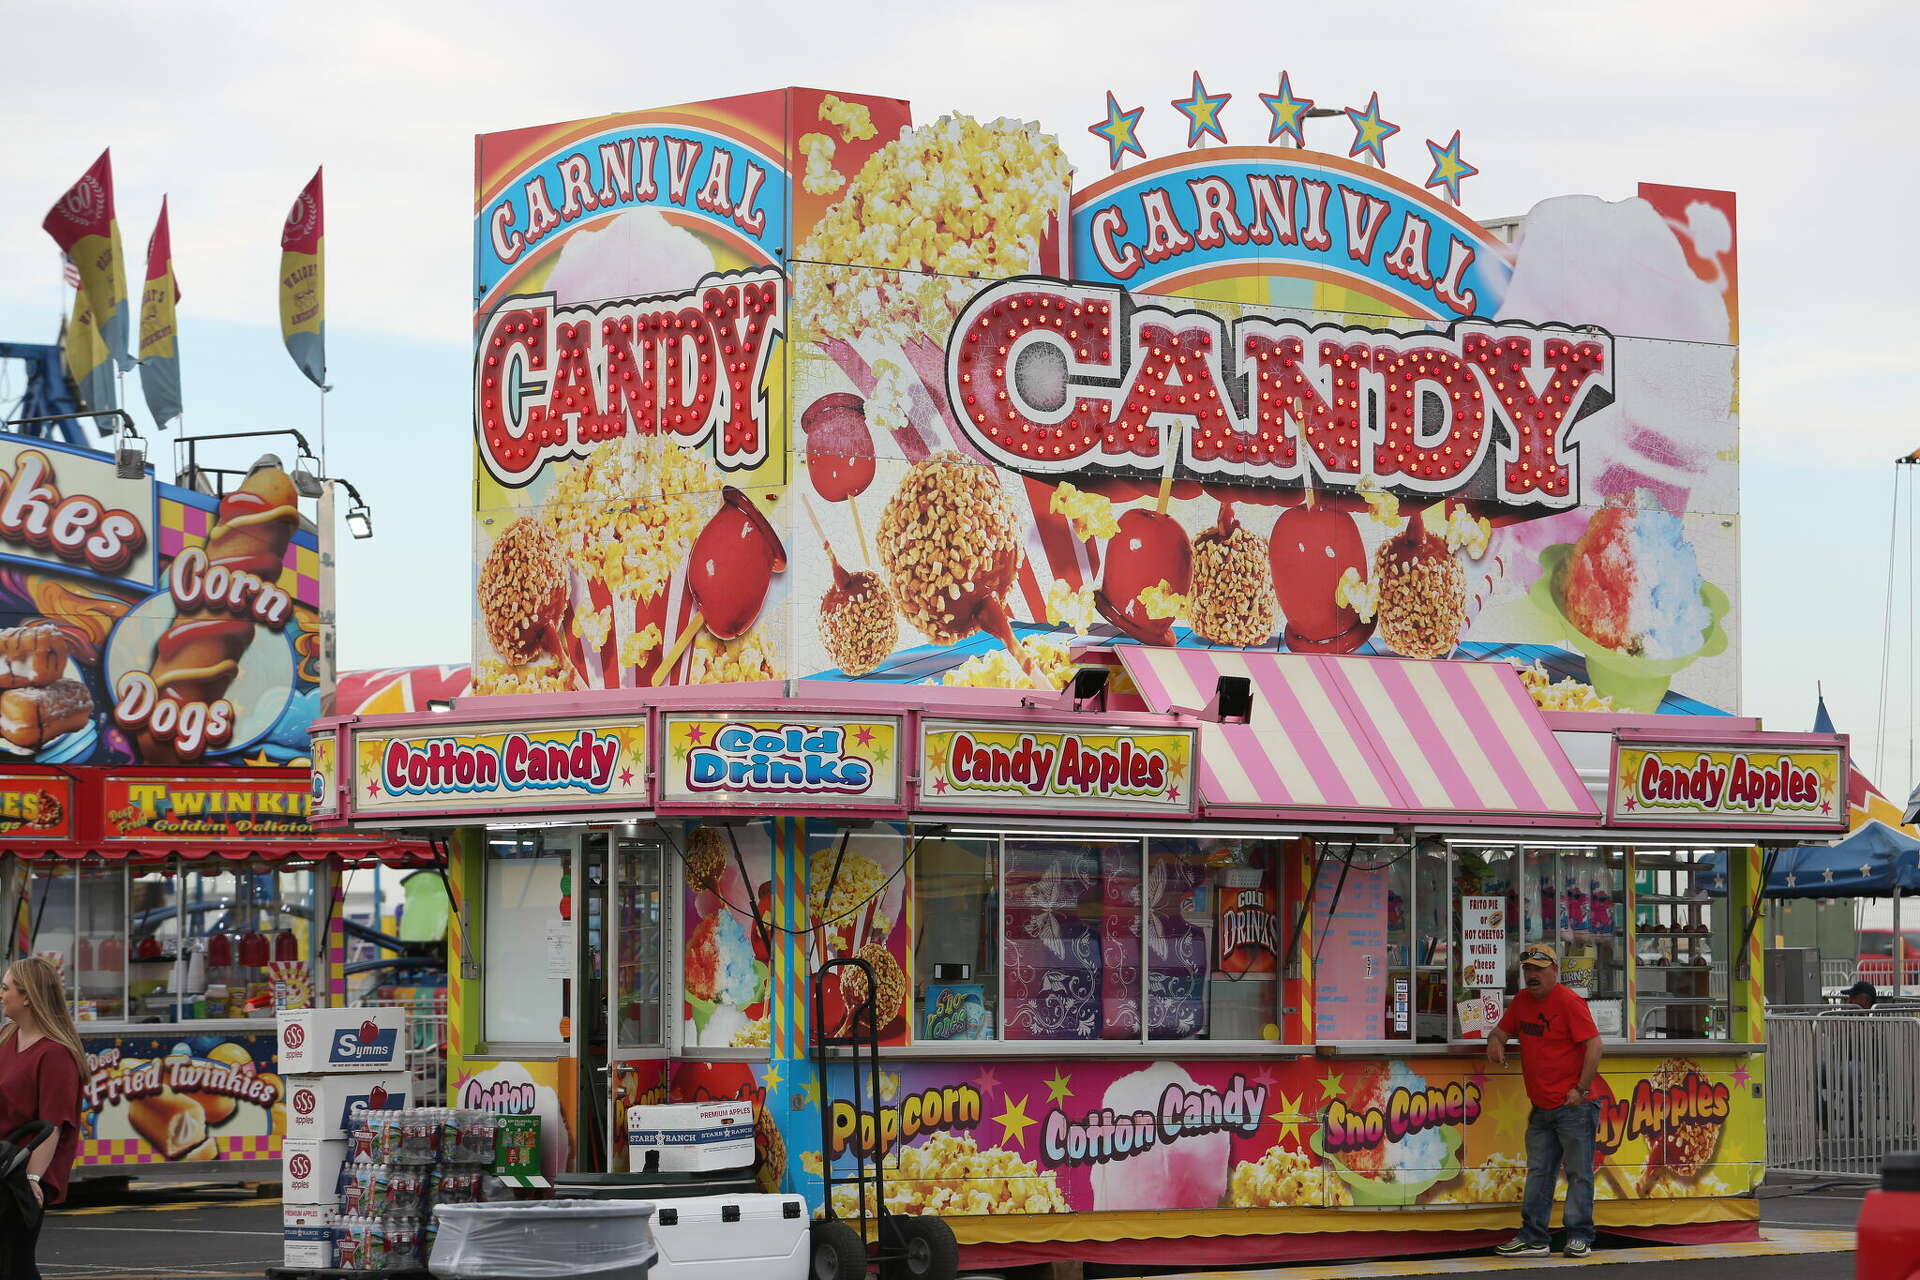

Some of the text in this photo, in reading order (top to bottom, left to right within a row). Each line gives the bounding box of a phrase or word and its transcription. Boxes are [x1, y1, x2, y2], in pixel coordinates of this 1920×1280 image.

[490, 136, 766, 265] CARNIVAL
[1089, 174, 1478, 317] CARNIVAL
[479, 278, 778, 476] CANDY
[952, 290, 1604, 498] CANDY
[0, 450, 142, 562] kes
[172, 548, 292, 626] Corn
[117, 672, 233, 755] Dogs
[386, 738, 497, 788] Cotton
[505, 731, 617, 787] Candy
[717, 727, 840, 755] Cold
[951, 734, 1164, 793] Candy Apples
[693, 751, 867, 787] Drinks
[1640, 756, 1818, 808] Candy Apples
[153, 819, 227, 833] Golden
[1237, 890, 1264, 908] COLD
[1469, 899, 1498, 910] FRITO PIE
[1480, 916, 1488, 925] or
[1223, 909, 1278, 956] DRINKS
[1464, 929, 1504, 940] HOT CHEETOS
[1474, 959, 1496, 969] Cheese
[337, 1033, 389, 1059] Symms
[85, 1054, 277, 1107] Fried Twinkies
[1160, 1074, 1267, 1138] Candy
[1631, 1072, 1729, 1134] Apples
[630, 1133, 697, 1143] STARR RANCH
[700, 1106, 751, 1120] PREMIUM APPLES
[832, 1085, 981, 1154] Popcorn
[1044, 1110, 1155, 1162] Cotton
[1326, 1083, 1481, 1146] Sno Cones
